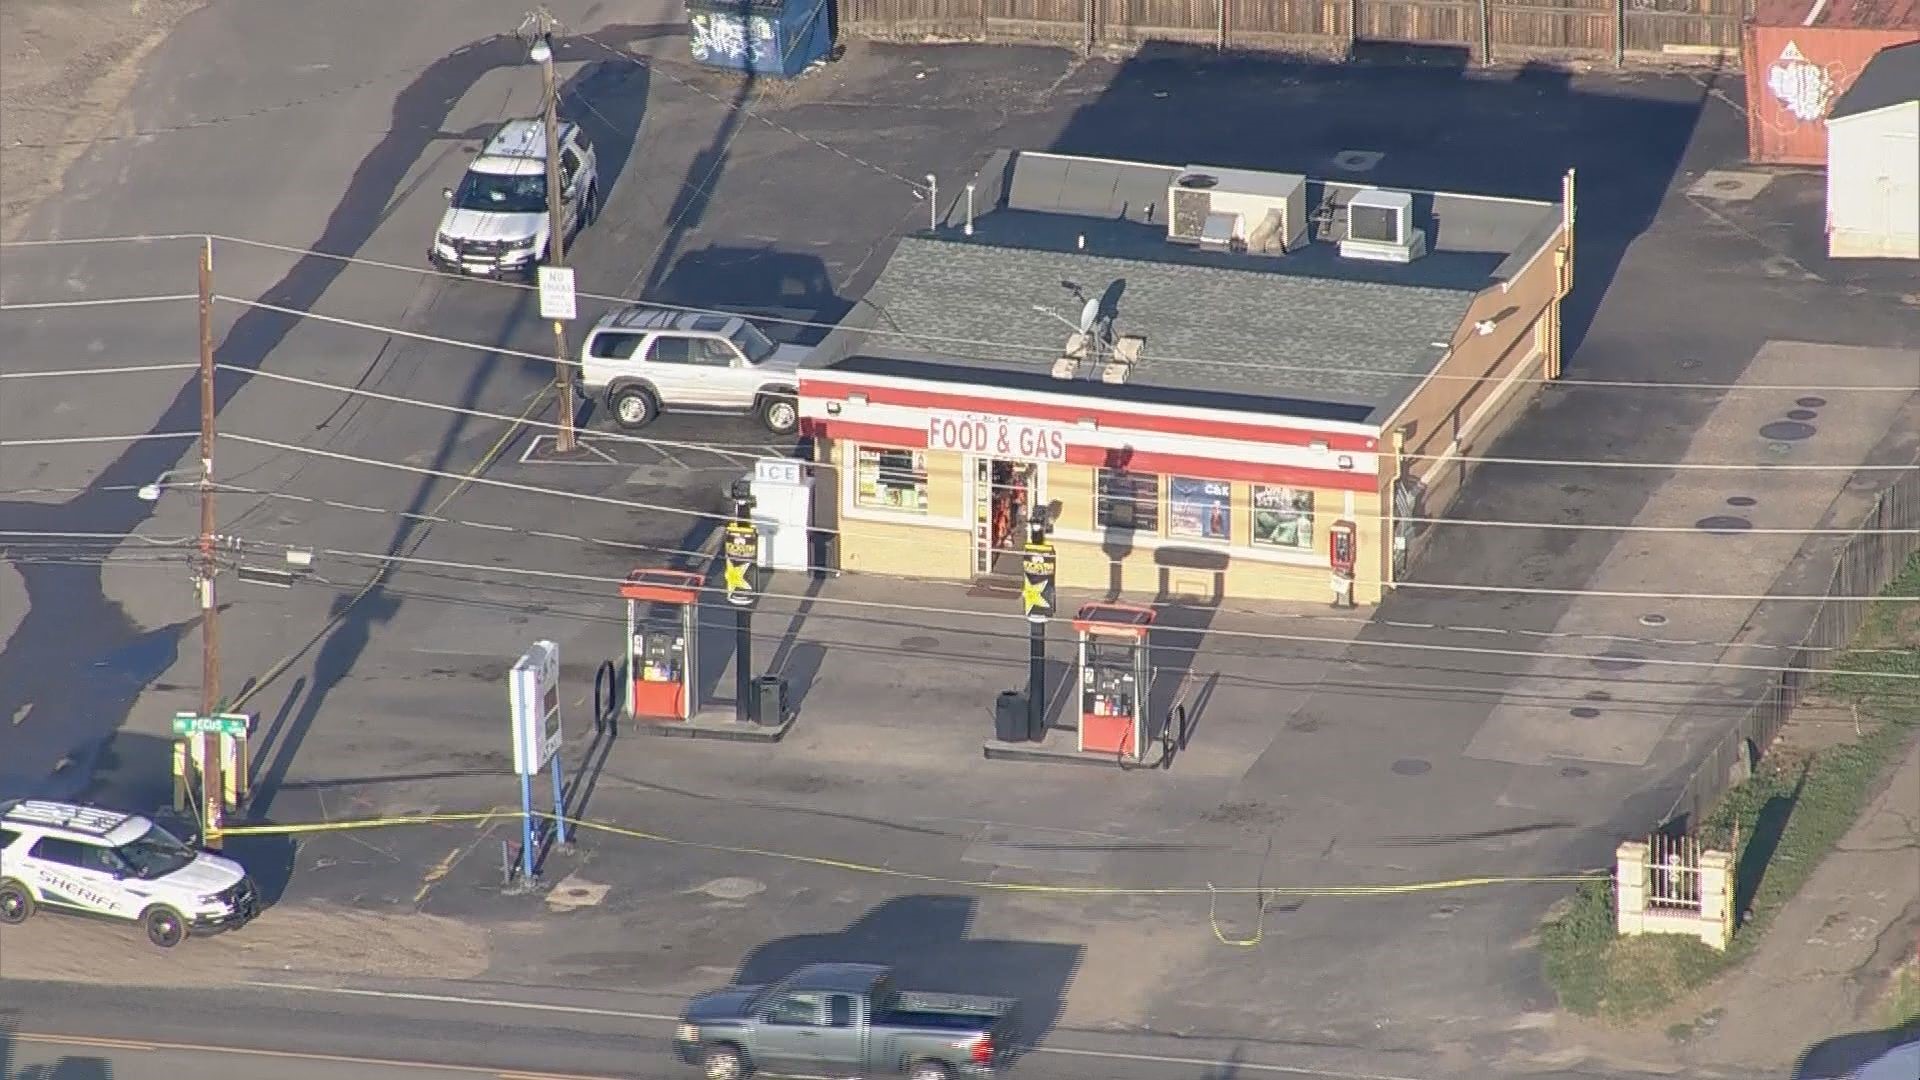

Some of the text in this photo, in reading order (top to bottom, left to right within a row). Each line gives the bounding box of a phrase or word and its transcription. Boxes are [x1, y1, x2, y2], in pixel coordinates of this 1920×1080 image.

[930, 416, 1063, 460] FOOD & GAS
[759, 464, 795, 481] ICE
[40, 869, 122, 911] SHERIFF
